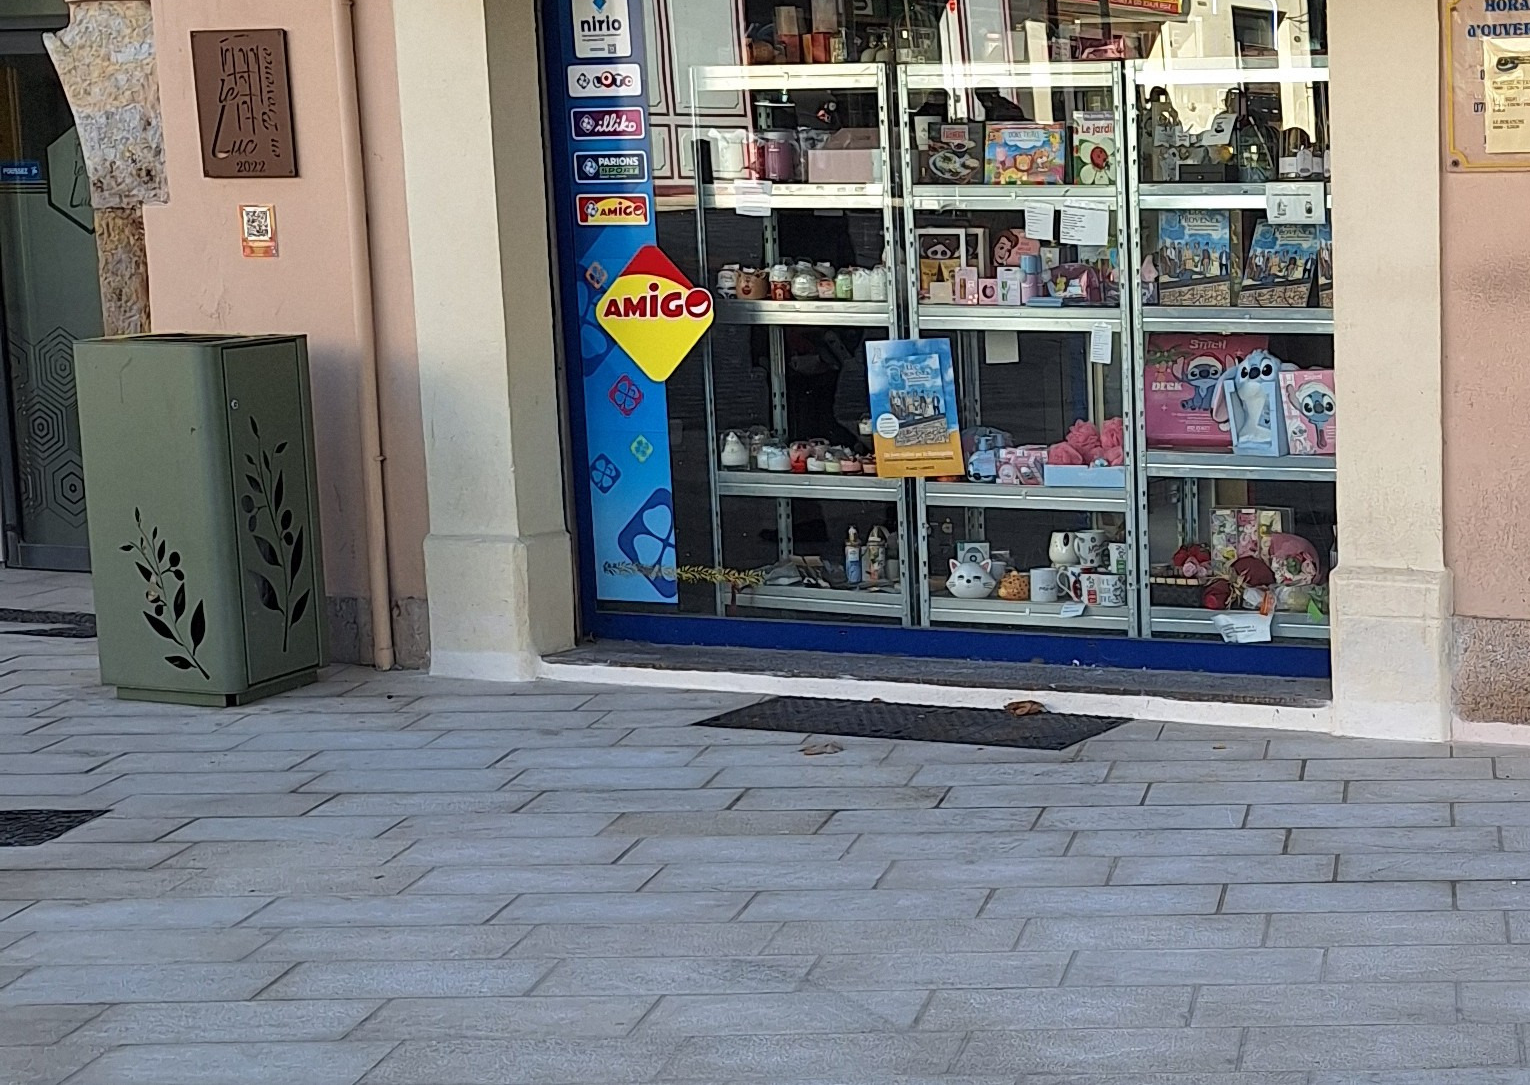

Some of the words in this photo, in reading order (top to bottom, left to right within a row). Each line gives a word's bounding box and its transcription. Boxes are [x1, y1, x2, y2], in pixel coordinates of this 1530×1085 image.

[580, 15, 622, 33] nirio
[592, 70, 634, 88] LOTO
[594, 112, 637, 133] illiko
[236, 159, 267, 173] 2022
[598, 156, 639, 166] PARIONS
[600, 167, 638, 175] SPORT
[599, 201, 646, 217] AMIGO
[602, 282, 713, 318] AMIGO
